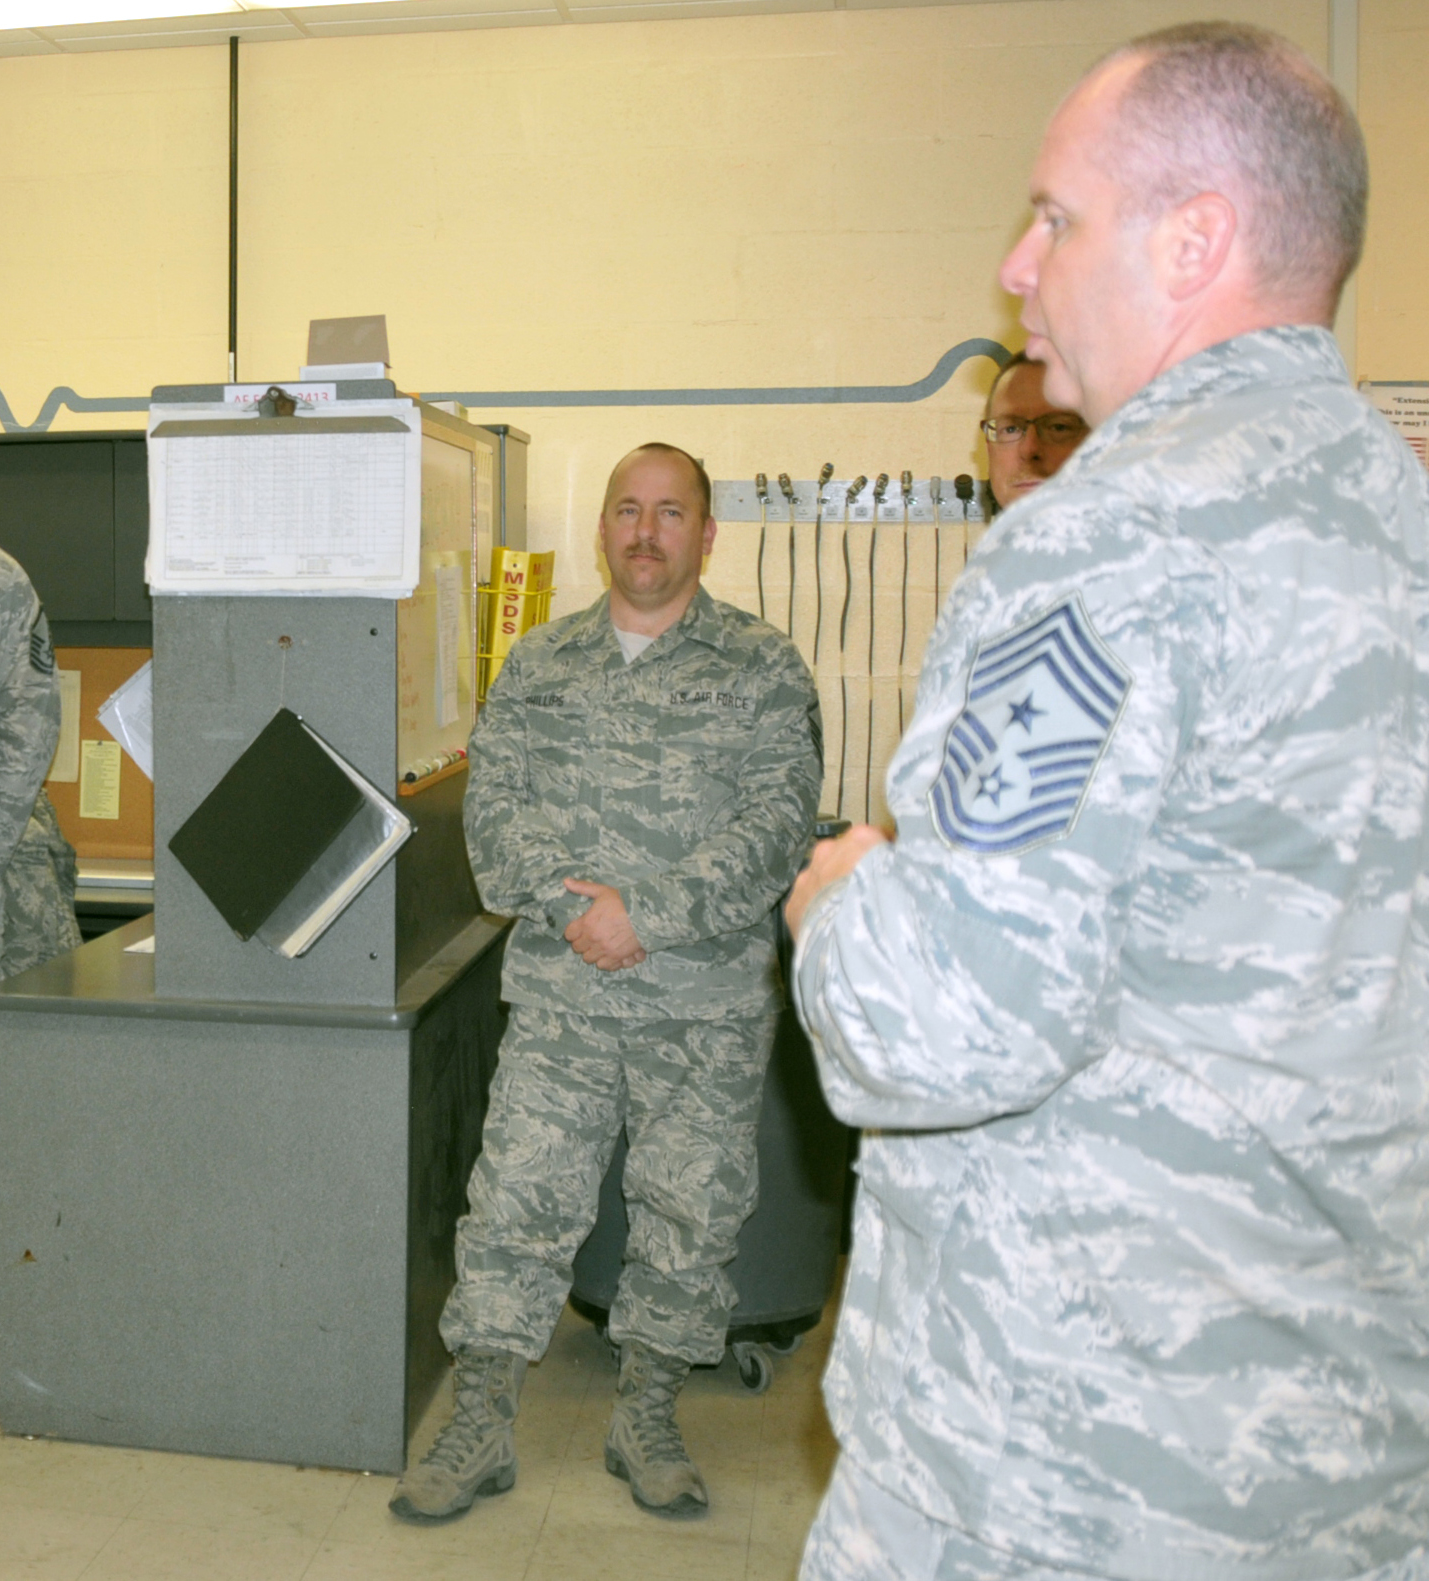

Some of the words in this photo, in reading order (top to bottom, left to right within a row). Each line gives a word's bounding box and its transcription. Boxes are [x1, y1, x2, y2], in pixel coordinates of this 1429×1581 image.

[502, 571, 524, 635] MSDS
[694, 691, 712, 704] AIR
[716, 692, 749, 710] FORCE
